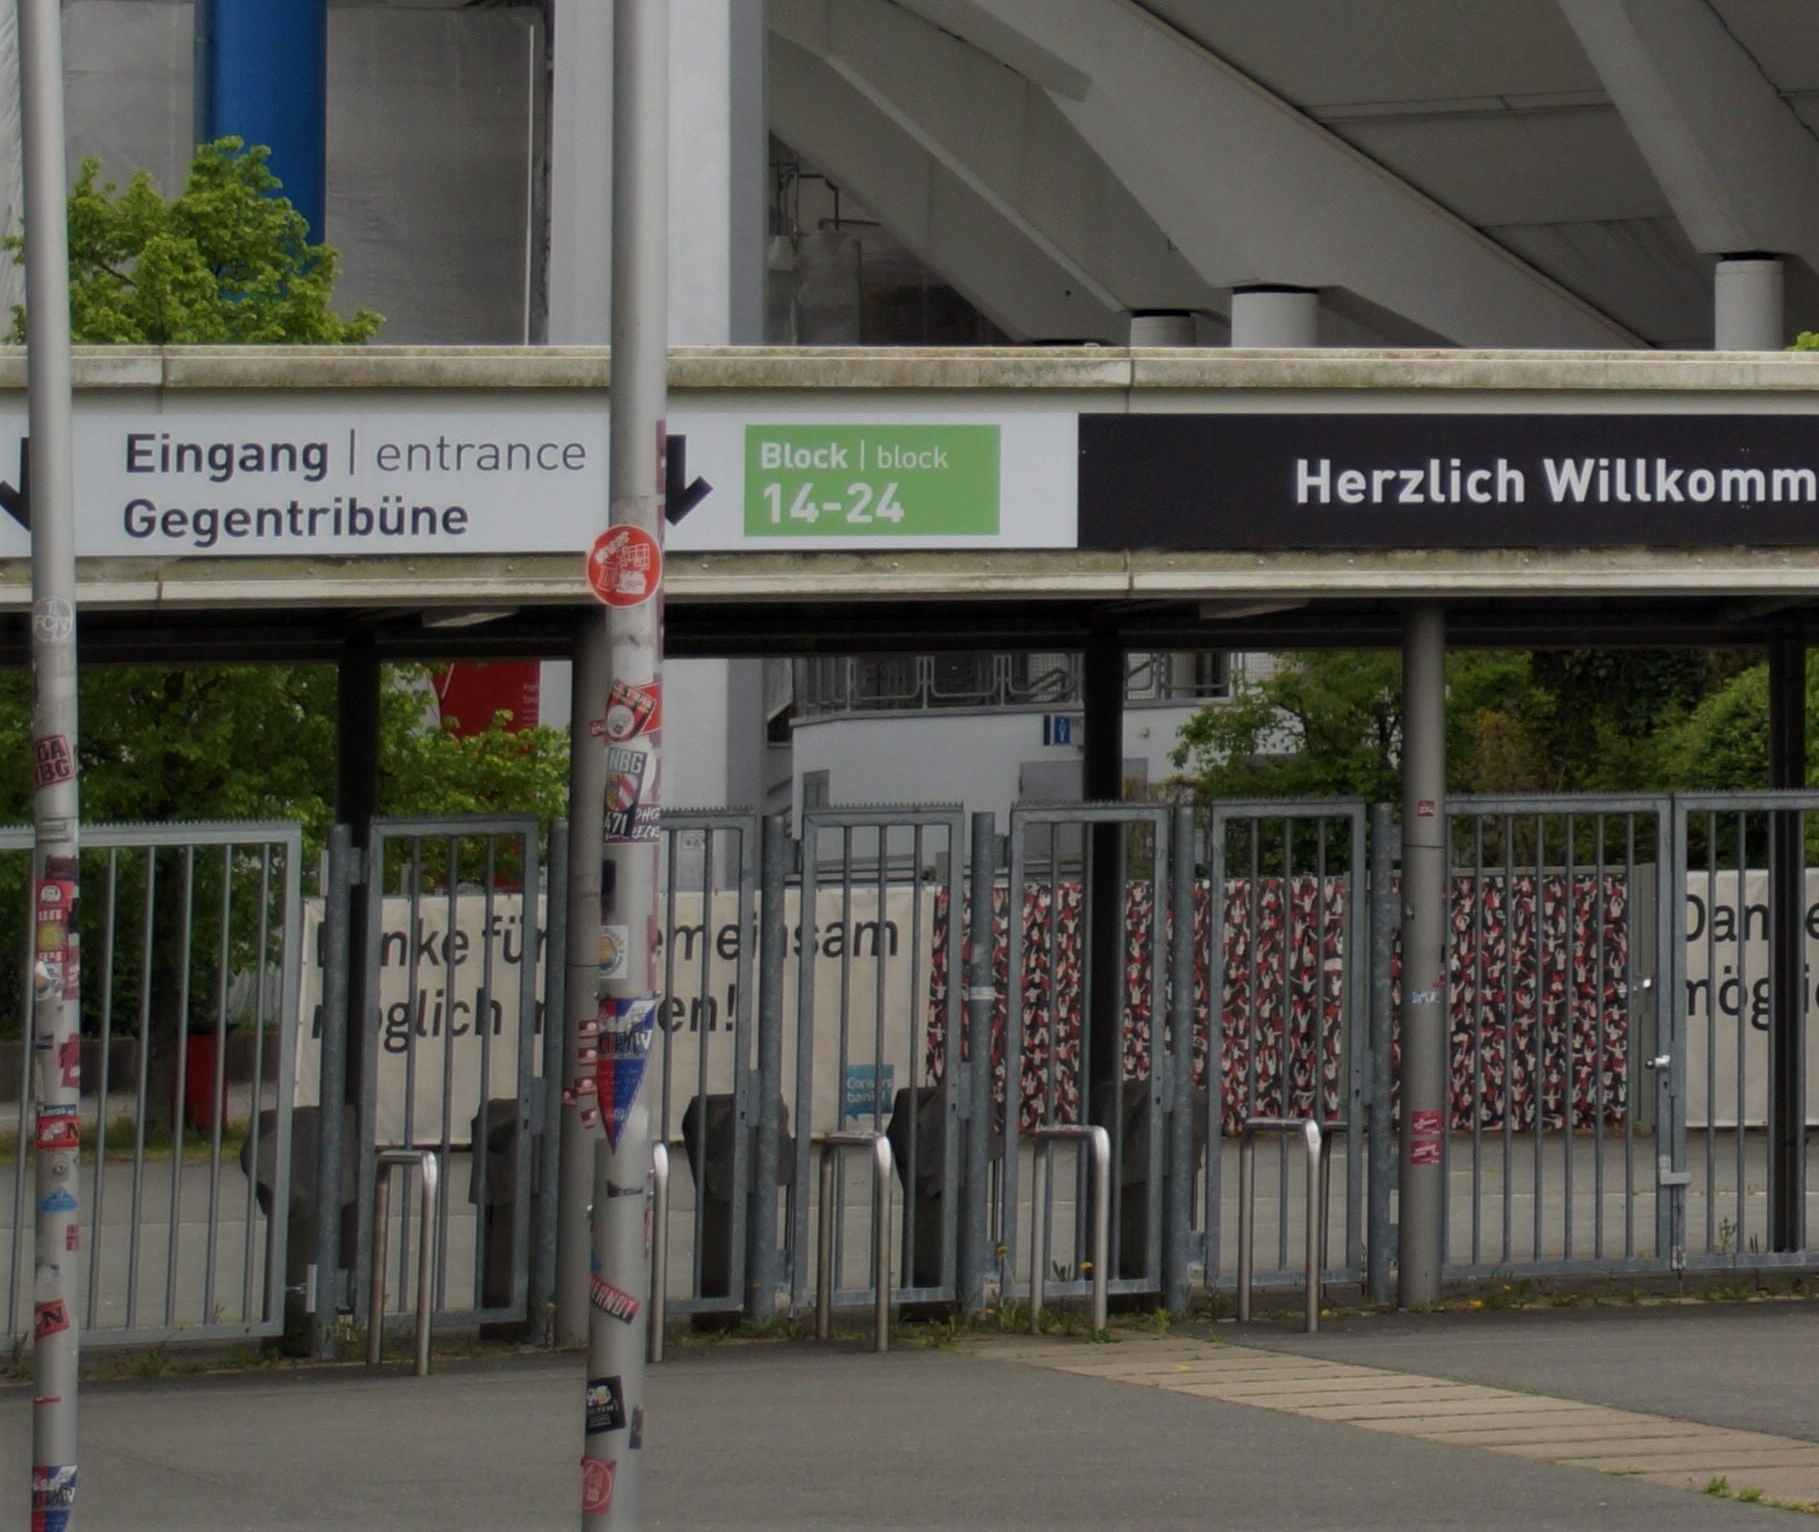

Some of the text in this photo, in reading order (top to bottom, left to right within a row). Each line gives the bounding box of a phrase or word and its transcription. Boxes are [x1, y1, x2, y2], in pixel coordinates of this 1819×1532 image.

[126, 433, 586, 483] Eingang entrance
[760, 441, 949, 469] Block block
[763, 482, 905, 524] 14-24
[1296, 458, 1525, 504] Herzlich
[123, 495, 468, 549] Gegentribüne
[608, 749, 644, 774] NBG
[316, 917, 470, 969] nke
[311, 987, 503, 1054] glich
